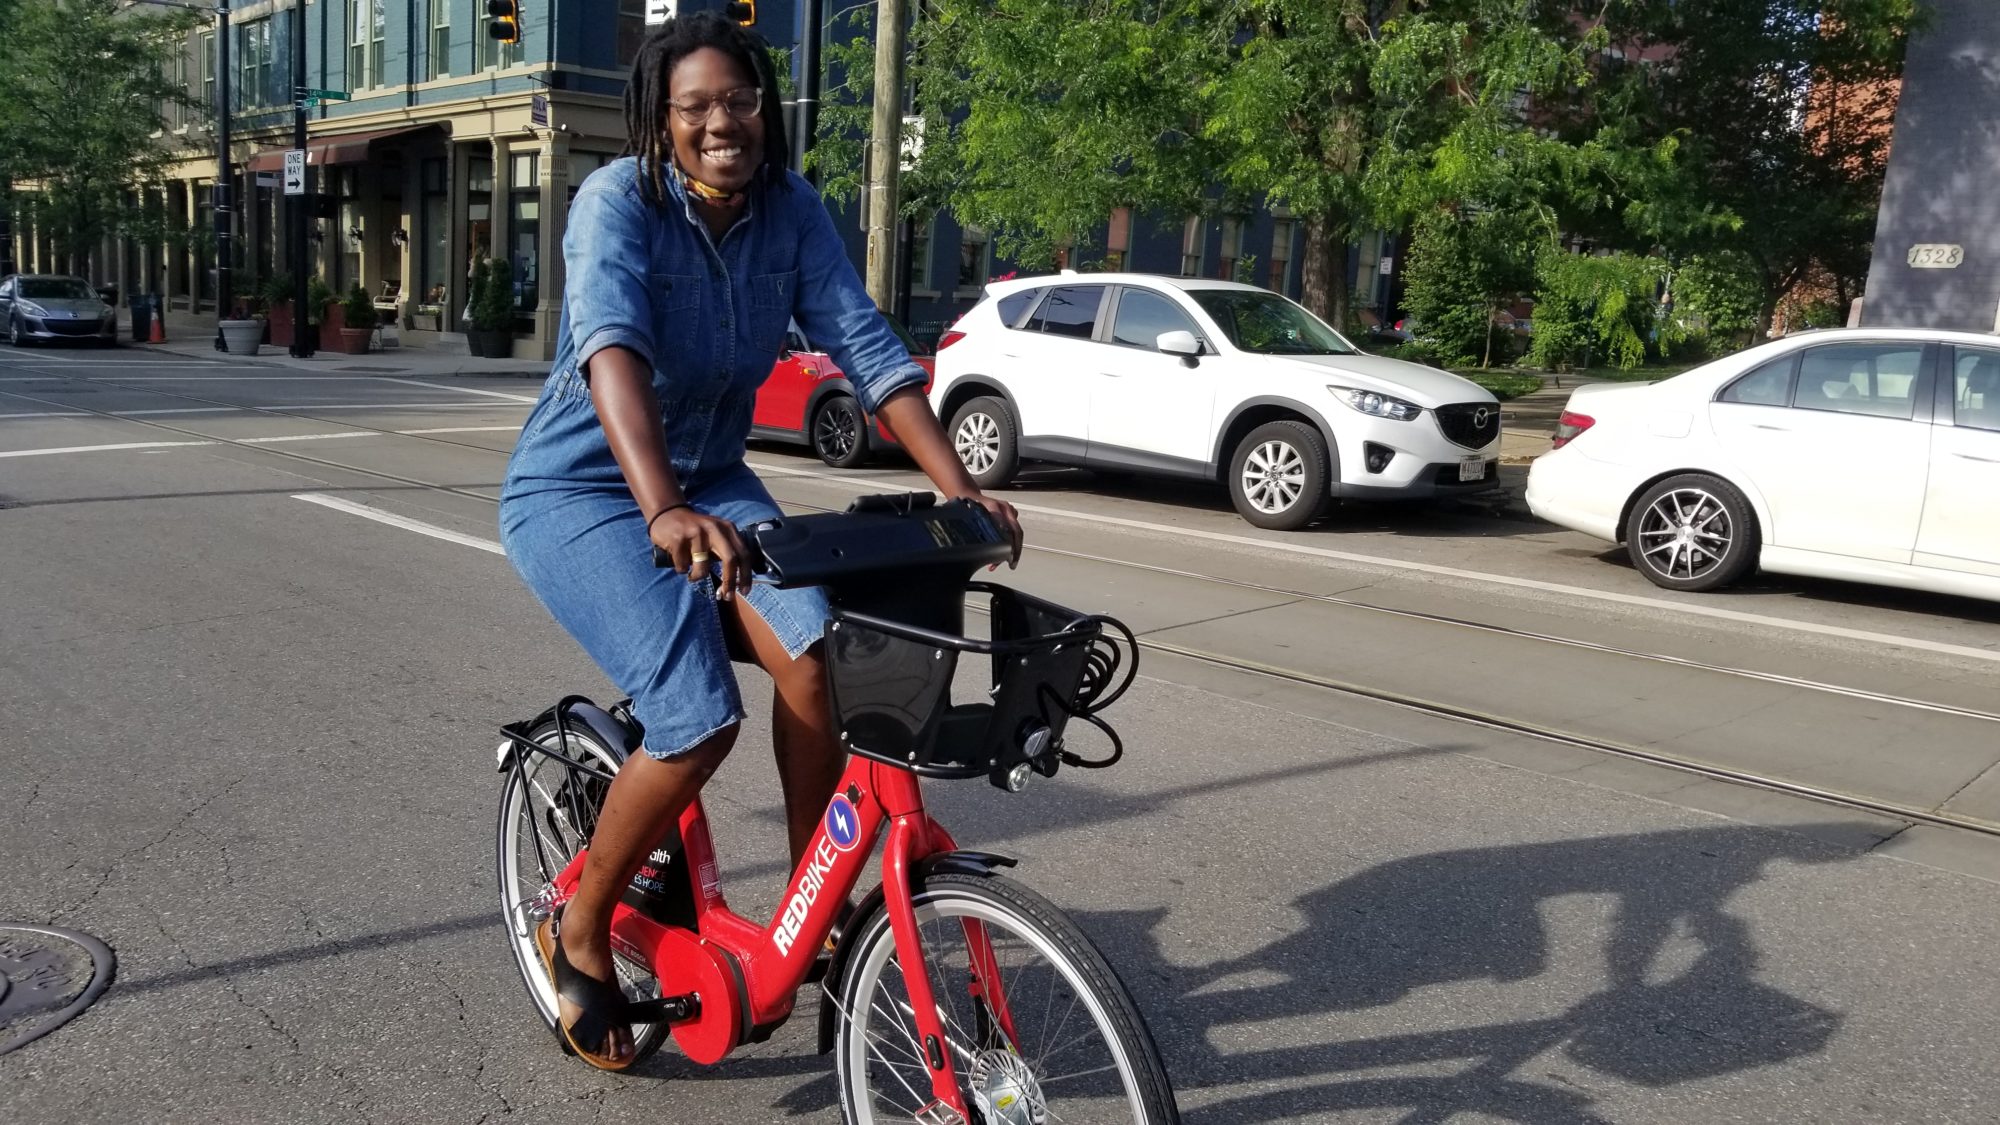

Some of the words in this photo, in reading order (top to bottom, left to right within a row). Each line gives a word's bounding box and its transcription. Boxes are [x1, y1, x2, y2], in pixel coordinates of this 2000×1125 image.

[287, 153, 302, 164] ONE
[287, 166, 301, 176] WAY
[1910, 247, 1960, 264] 1328
[649, 848, 671, 865] alth
[772, 834, 838, 958] REDBIKE
